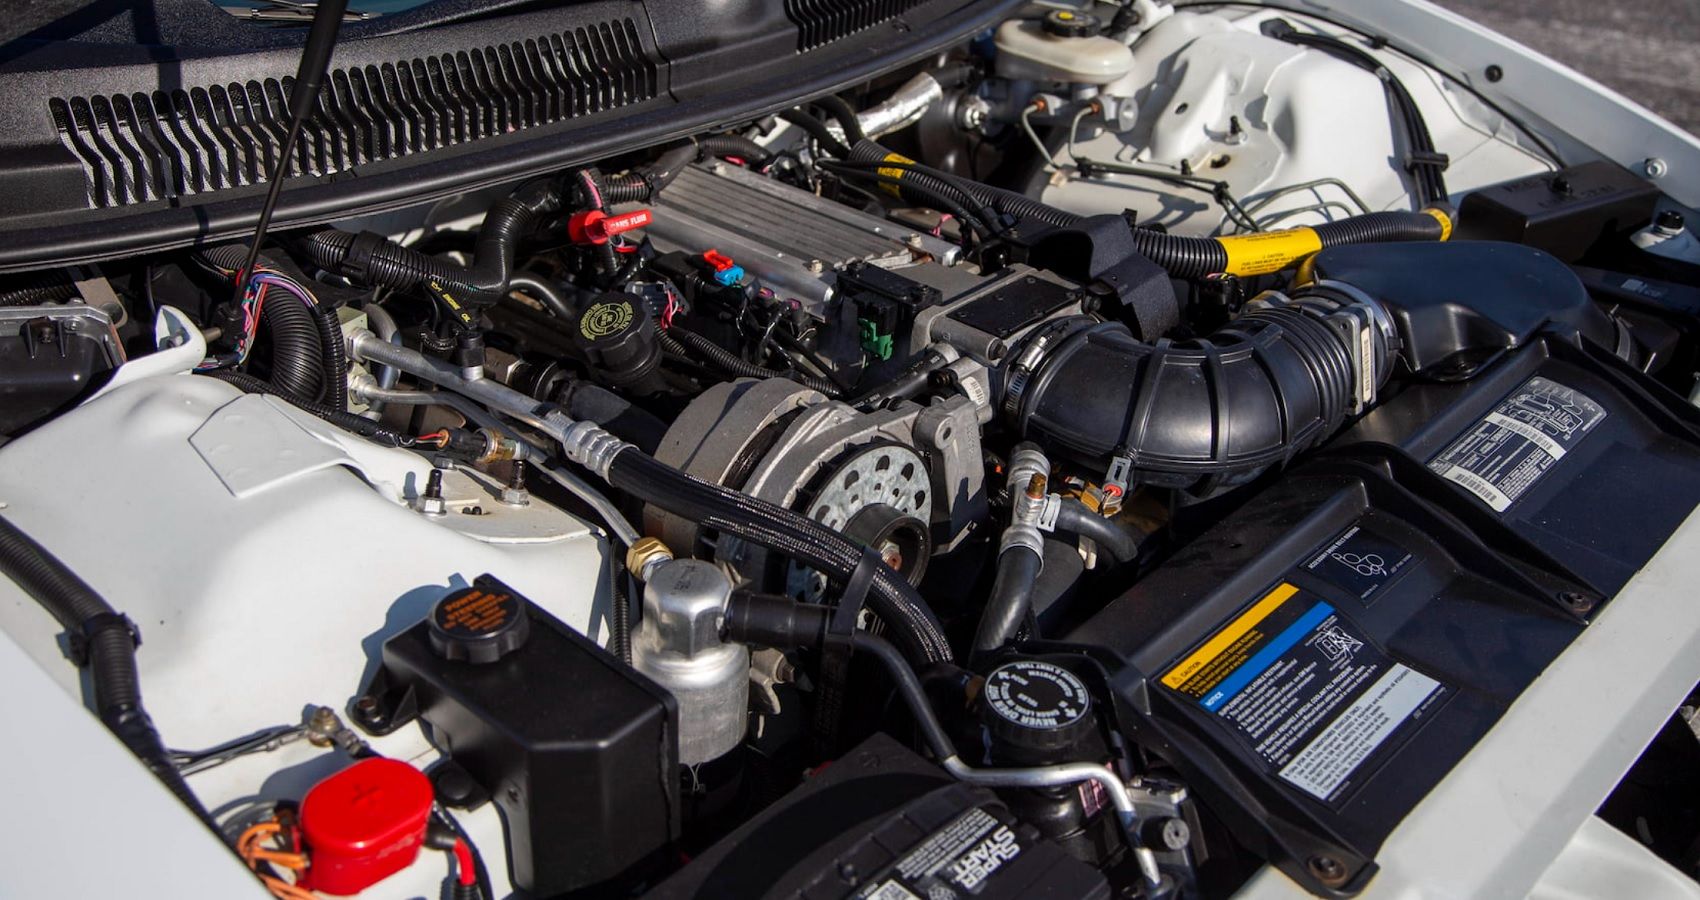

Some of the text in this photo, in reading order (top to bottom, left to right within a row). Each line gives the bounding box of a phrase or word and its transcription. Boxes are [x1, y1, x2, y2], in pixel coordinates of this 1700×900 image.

[461, 313, 470, 322] OIL
[444, 590, 482, 611] POWER
[447, 594, 496, 619] STEERING
[1028, 670, 1057, 681] SYSTEM
[1179, 660, 1202, 677] CAUTION
[988, 684, 1000, 700] HOT
[1203, 690, 1224, 707] NOTICE
[994, 700, 1019, 719] OPEN
[1021, 715, 1058, 726] NEVER
[954, 825, 1016, 882] START
[961, 843, 1020, 889] SUPER
